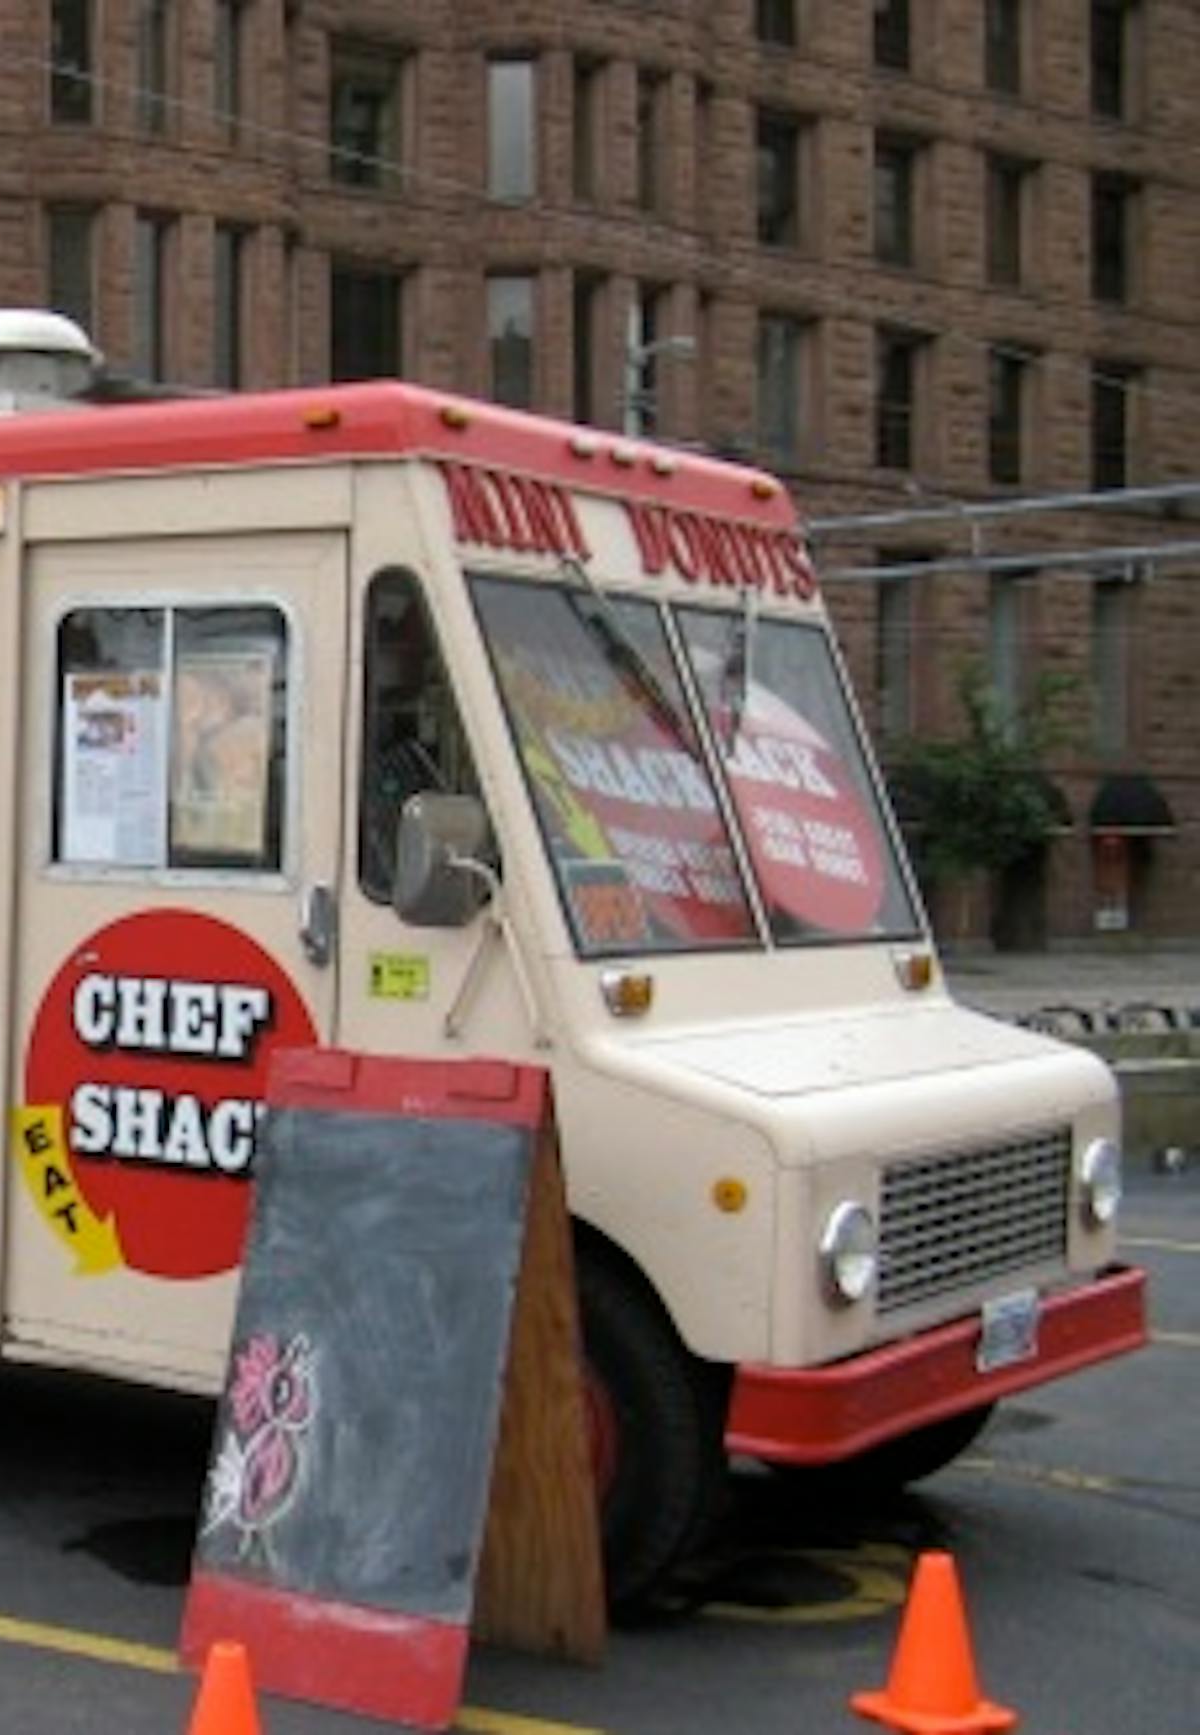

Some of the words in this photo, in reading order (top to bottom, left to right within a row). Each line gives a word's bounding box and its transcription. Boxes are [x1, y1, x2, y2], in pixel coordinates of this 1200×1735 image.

[441, 462, 592, 562] MINI
[625, 500, 817, 601] DONUTS
[72, 972, 272, 1058] CHEF
[22, 1119, 78, 1234] EAT
[69, 1082, 268, 1171] SHAC
